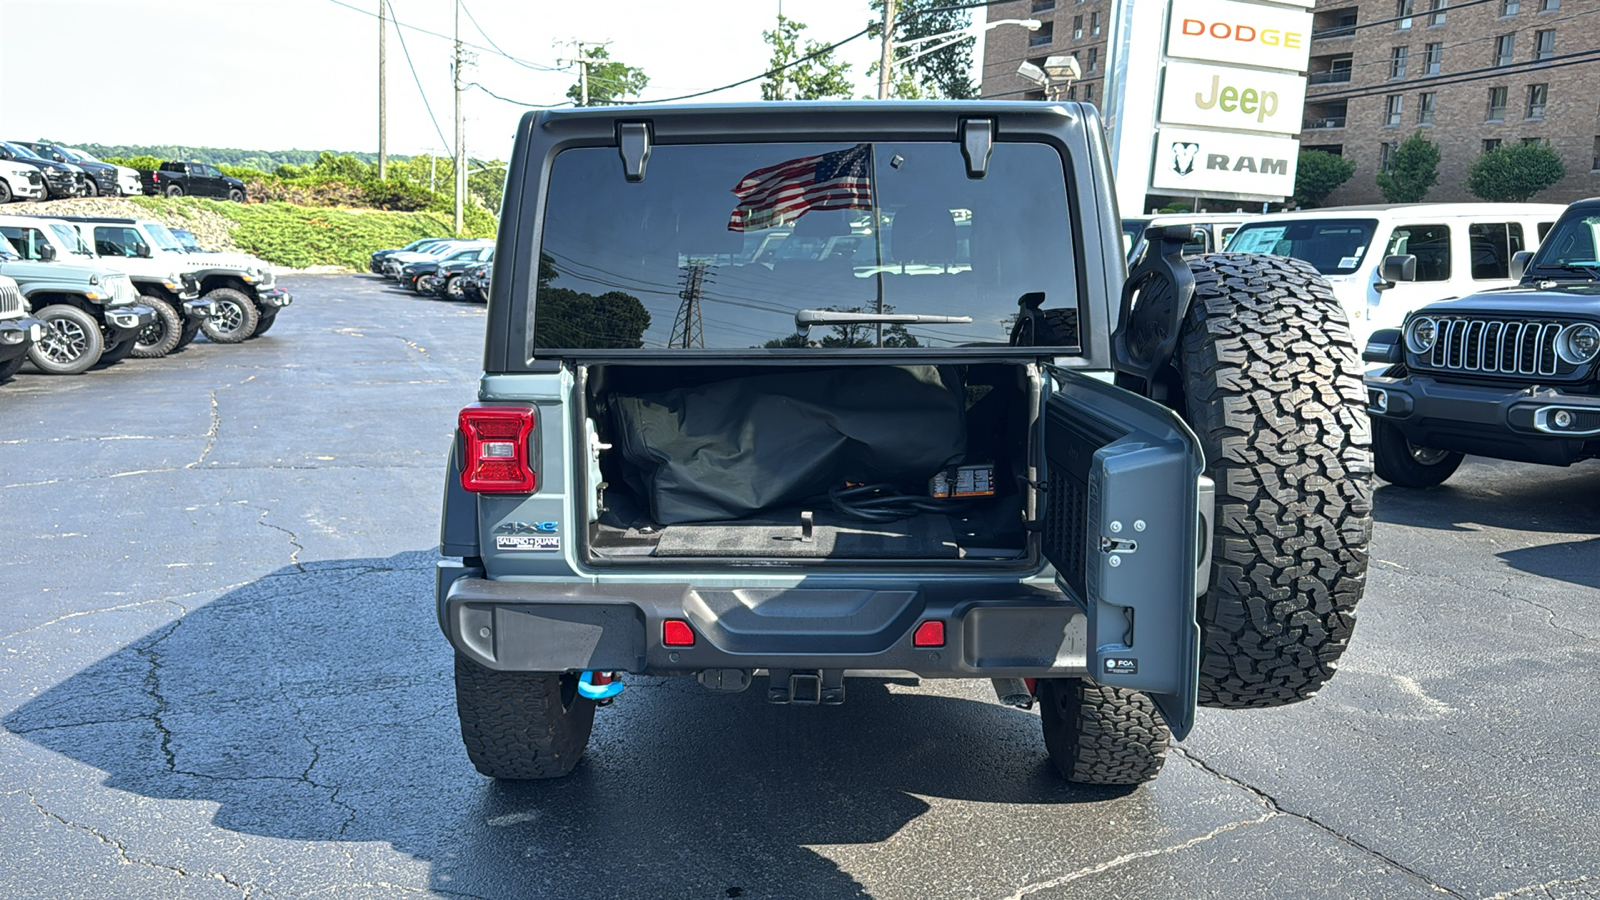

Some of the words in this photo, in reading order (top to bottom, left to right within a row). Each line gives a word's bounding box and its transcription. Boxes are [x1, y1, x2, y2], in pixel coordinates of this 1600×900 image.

[1182, 18, 1302, 49] DODGE
[1195, 75, 1279, 123] Jeep
[1206, 153, 1288, 175] RAM
